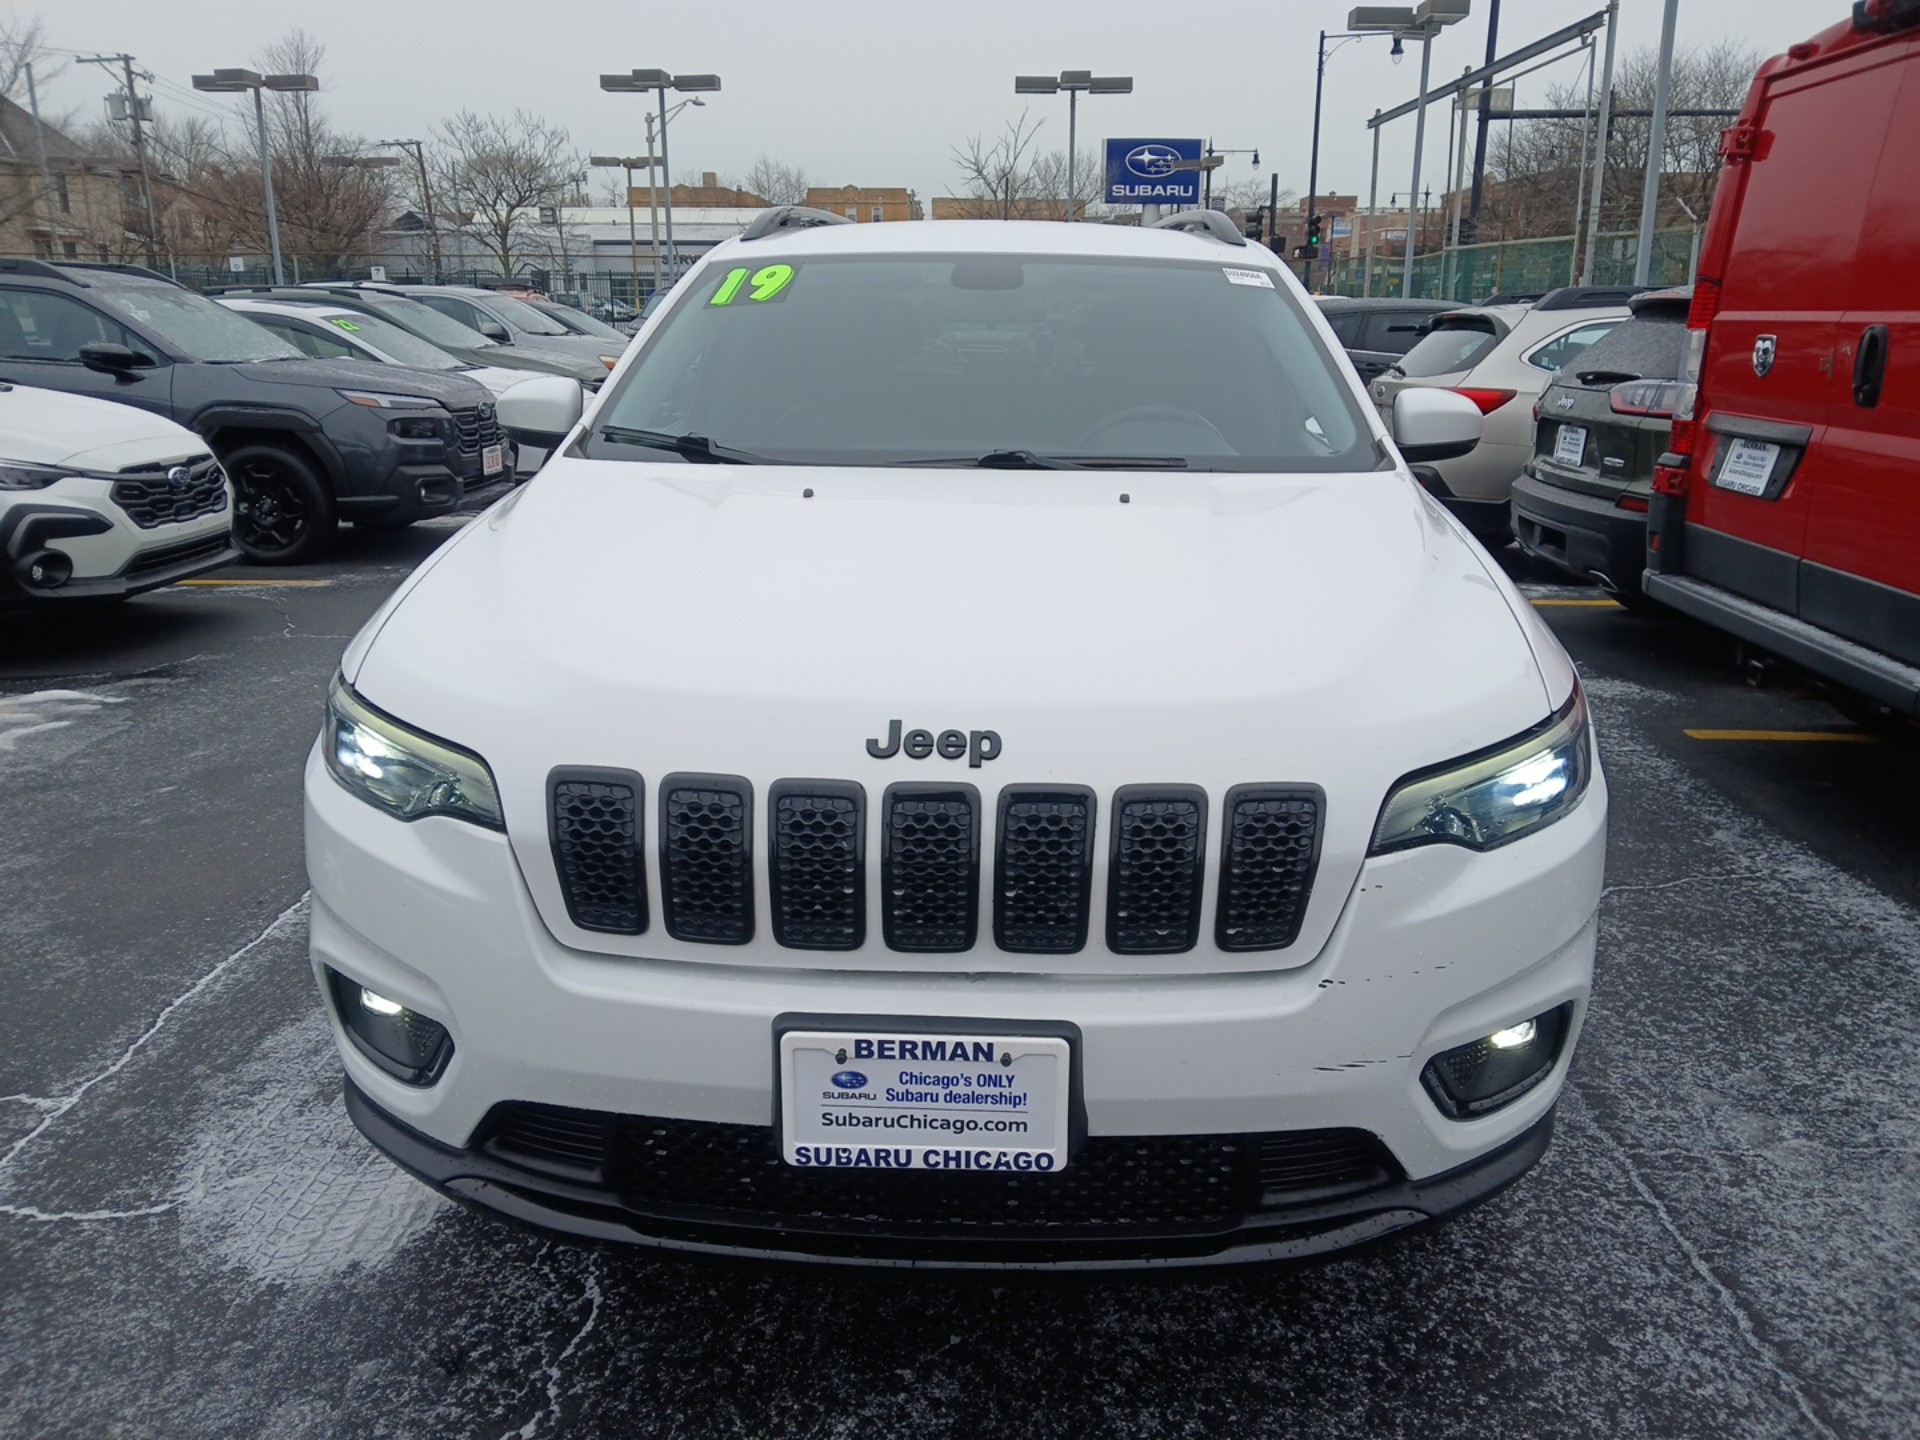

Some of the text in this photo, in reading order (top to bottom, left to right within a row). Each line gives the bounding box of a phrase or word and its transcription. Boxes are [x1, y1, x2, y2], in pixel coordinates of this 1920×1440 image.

[1111, 184, 1193, 197] SUBARU
[710, 264, 795, 306] 19
[865, 719, 1002, 769] Jeep
[854, 1039, 994, 1062] BERMAN
[899, 1070, 1016, 1090] Chicago's ONLY
[822, 1091, 877, 1101] SUBARU
[885, 1087, 1028, 1109] Subaru dealership!
[821, 1112, 1028, 1135] SubaruChicago.com
[795, 1146, 1055, 1172] SUBARU CHICAGO
